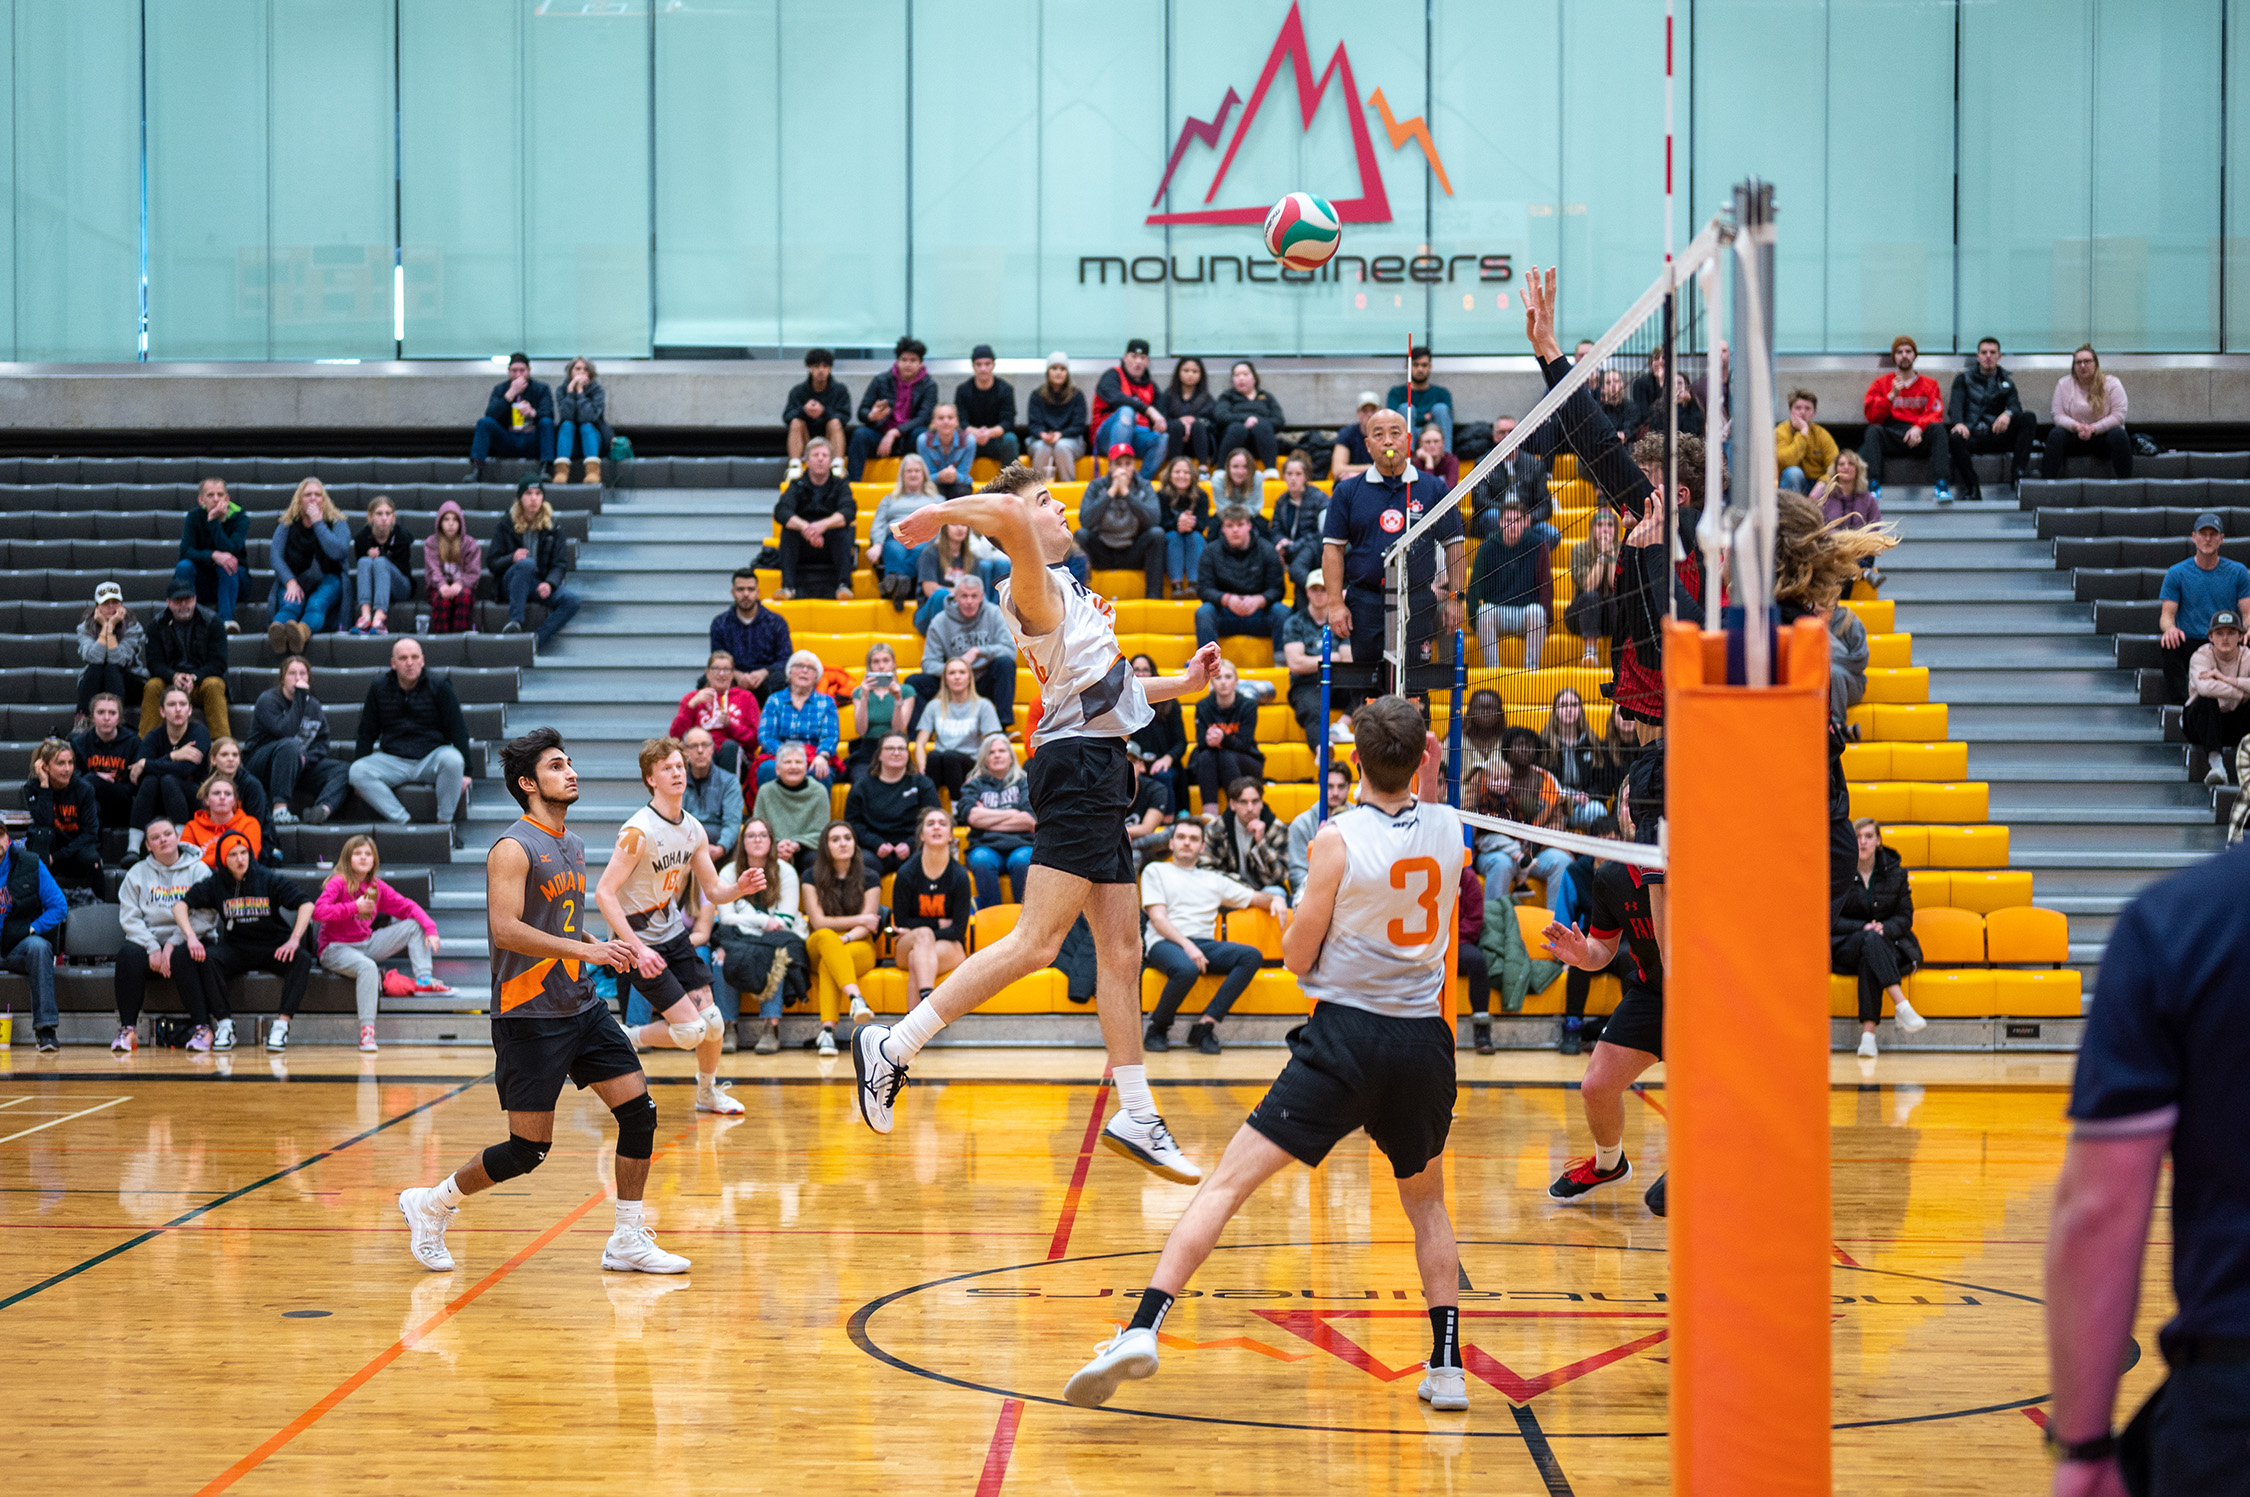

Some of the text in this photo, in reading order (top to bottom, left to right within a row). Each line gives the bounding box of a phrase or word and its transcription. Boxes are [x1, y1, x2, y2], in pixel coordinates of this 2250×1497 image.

[1079, 254, 1513, 284] mountaineers
[651, 850, 693, 873] MOHAW
[539, 870, 587, 902] MOHAW
[1387, 855, 1442, 948] 3
[562, 899, 575, 932] 2
[918, 893, 946, 918] M
